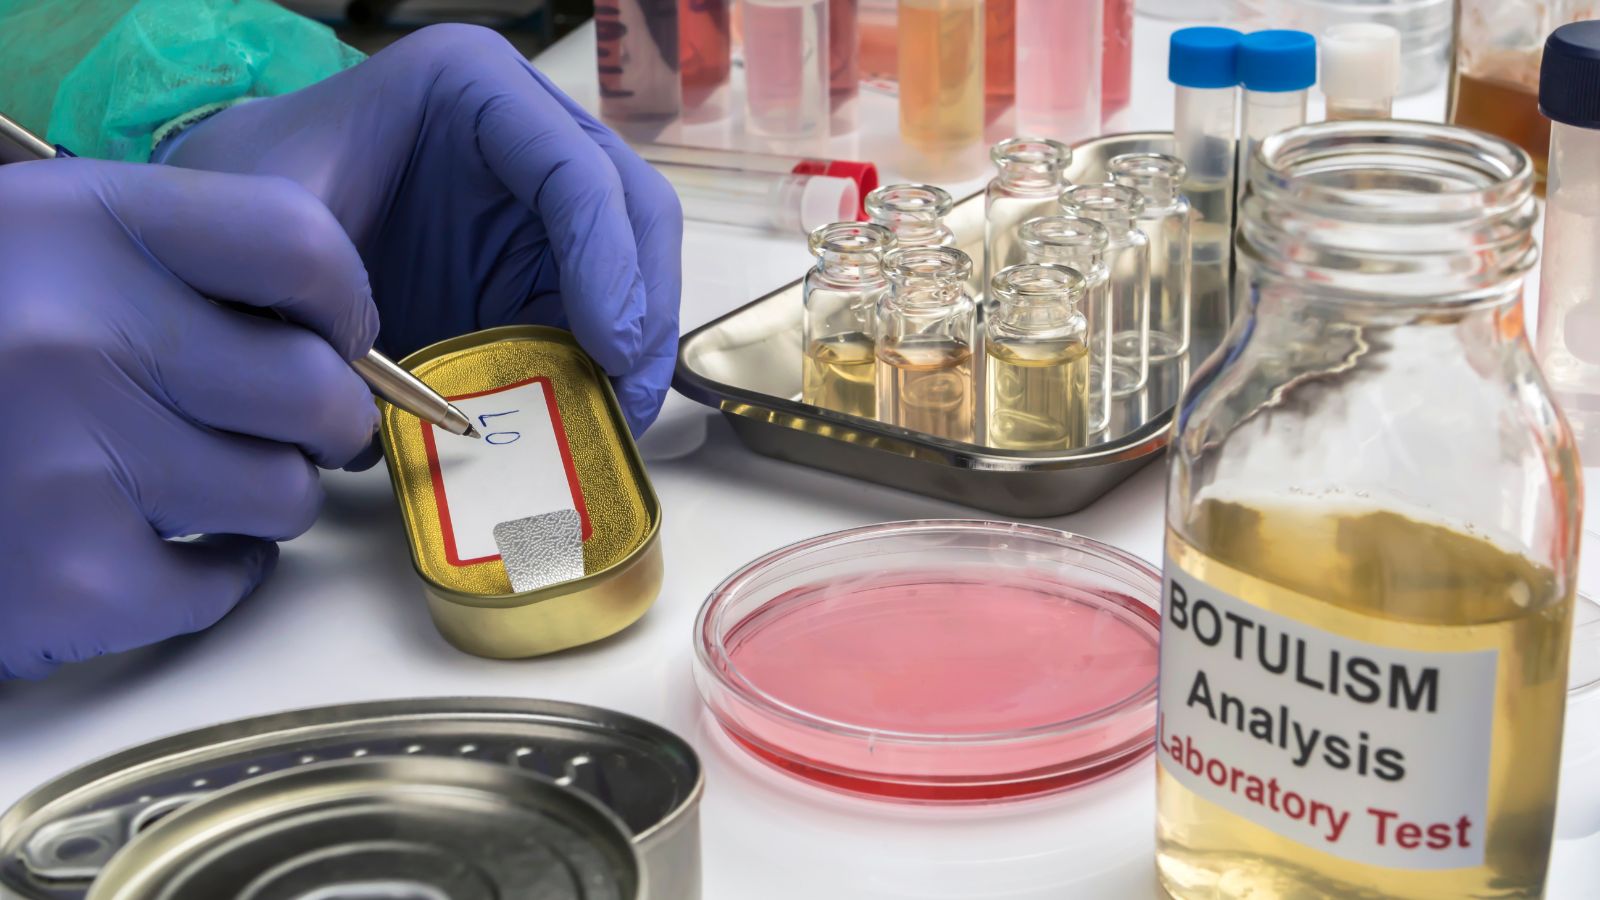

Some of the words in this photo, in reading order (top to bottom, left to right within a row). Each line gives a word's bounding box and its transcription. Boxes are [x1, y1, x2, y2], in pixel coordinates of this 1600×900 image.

[1169, 579, 1440, 713] BOTULISM
[1160, 711, 1350, 842] Laboratory
[1367, 806, 1472, 850] Test
[1186, 669, 1406, 782] Analysis
